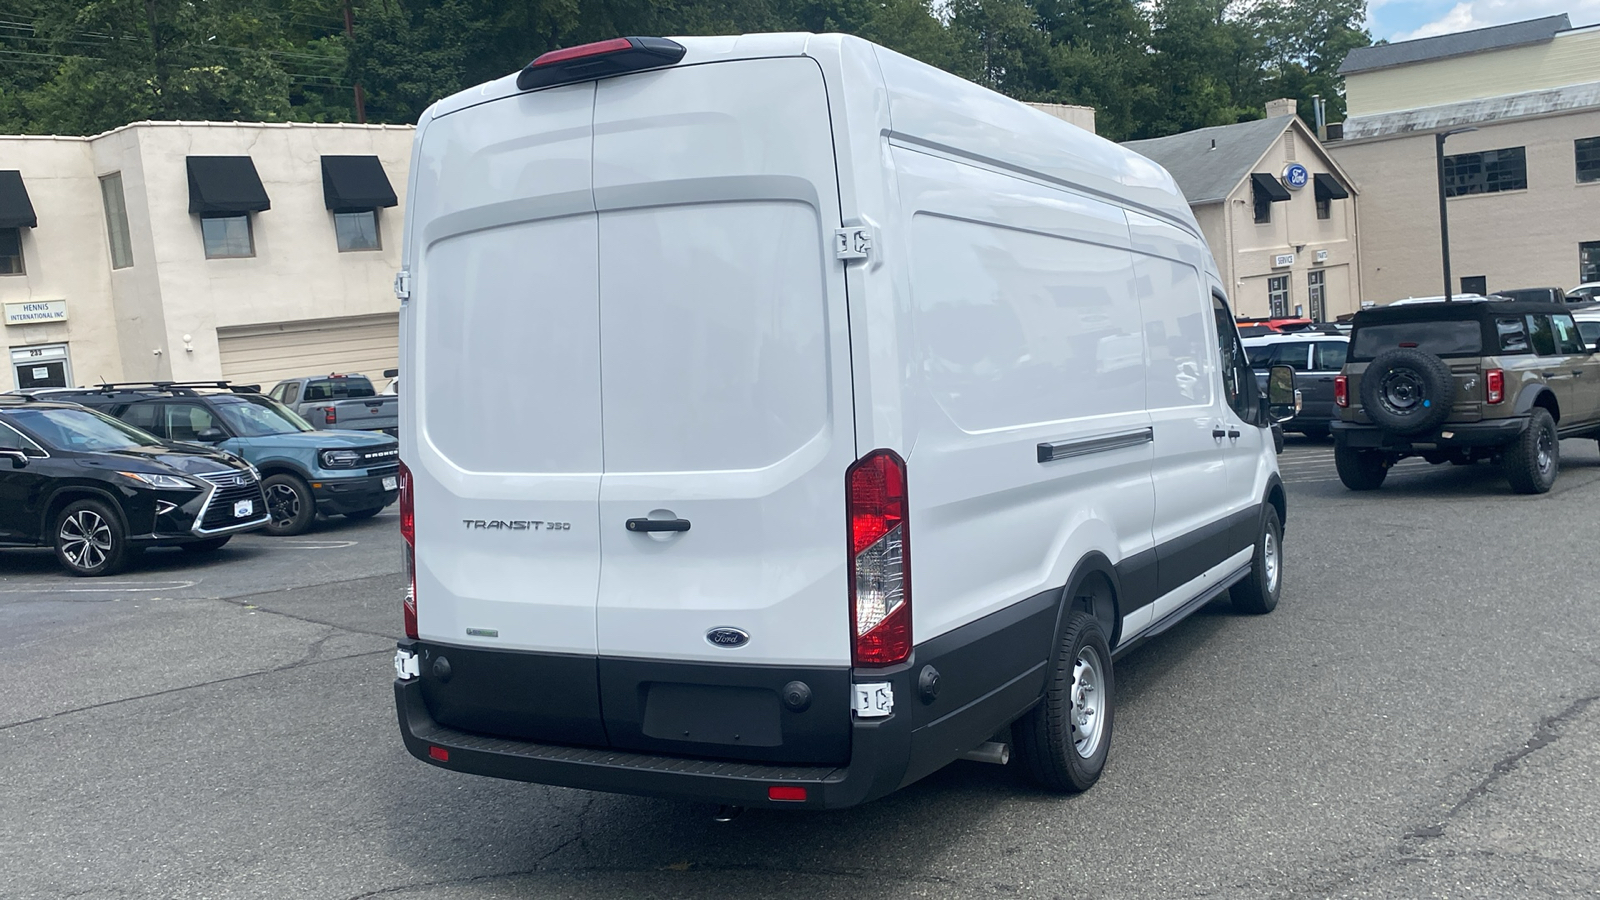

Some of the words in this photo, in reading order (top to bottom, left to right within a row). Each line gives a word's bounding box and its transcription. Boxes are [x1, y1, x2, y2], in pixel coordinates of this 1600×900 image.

[1291, 168, 1305, 184] Ford
[1277, 255, 1293, 265] SERVICE
[23, 303, 49, 312] HENNIS
[10, 312, 53, 321] INTERNATIONAL
[30, 349, 43, 357] 233
[364, 450, 399, 459] BRONCO
[462, 519, 544, 531] TRANSIT
[546, 521, 571, 531] 350
[714, 630, 739, 643] Ford
